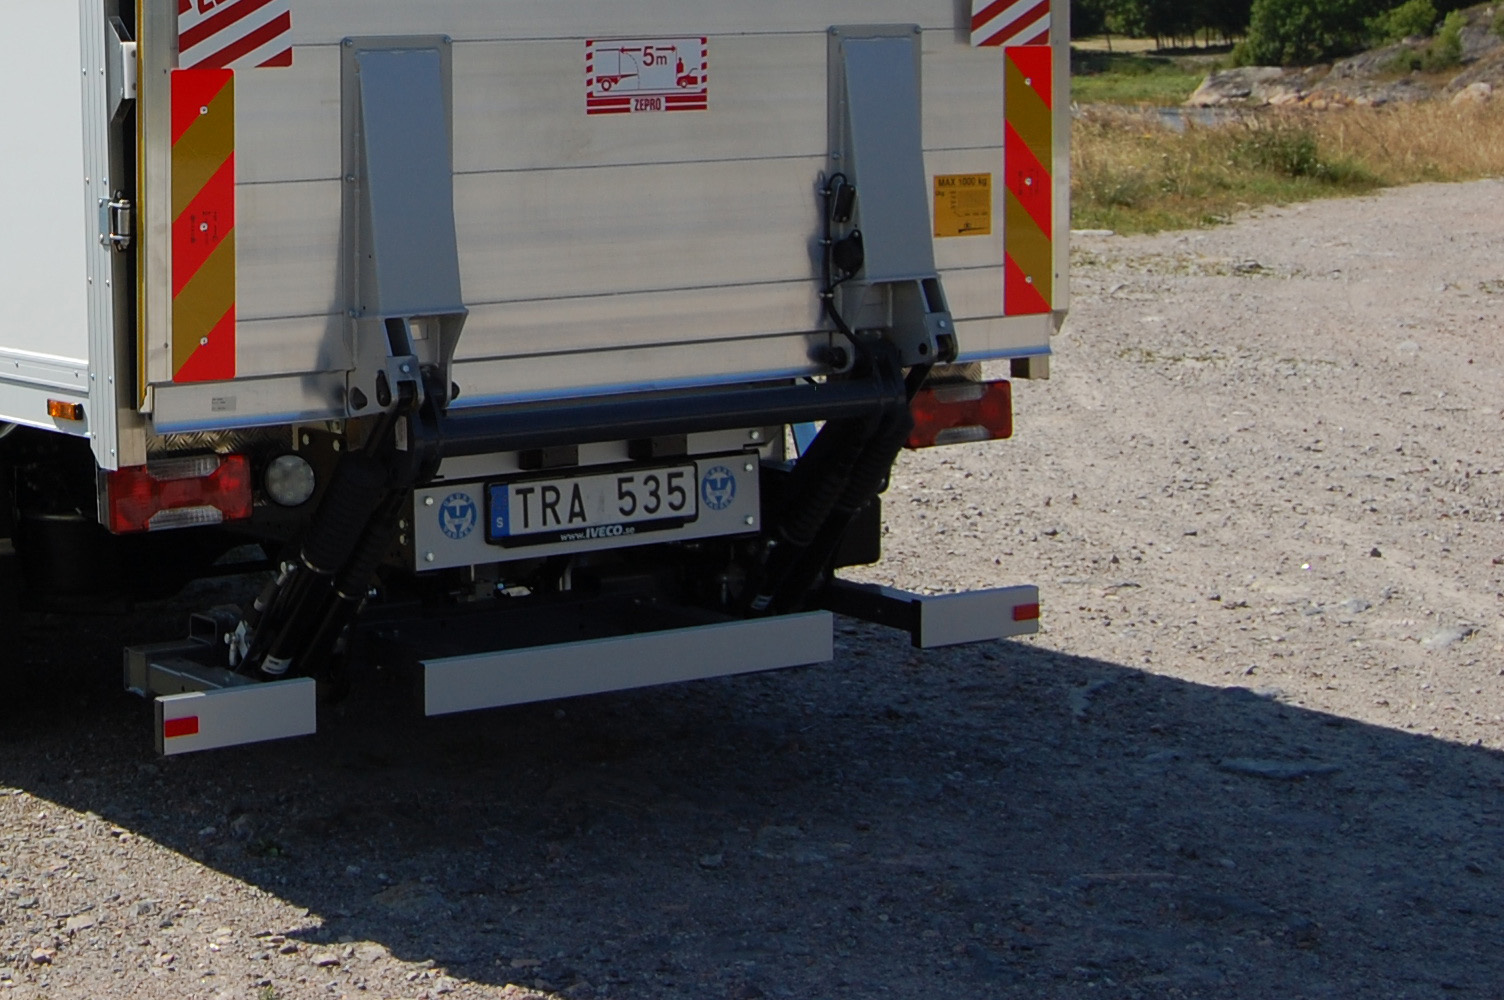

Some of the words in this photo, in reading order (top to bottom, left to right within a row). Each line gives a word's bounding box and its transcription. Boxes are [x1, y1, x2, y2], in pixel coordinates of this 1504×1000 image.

[634, 97, 662, 111] ZEPRO
[938, 178, 956, 187] MAX
[958, 178, 976, 187] 1000
[978, 177, 987, 187] kg
[495, 516, 504, 528] S
[515, 482, 588, 529] TRA
[617, 471, 687, 517] 535
